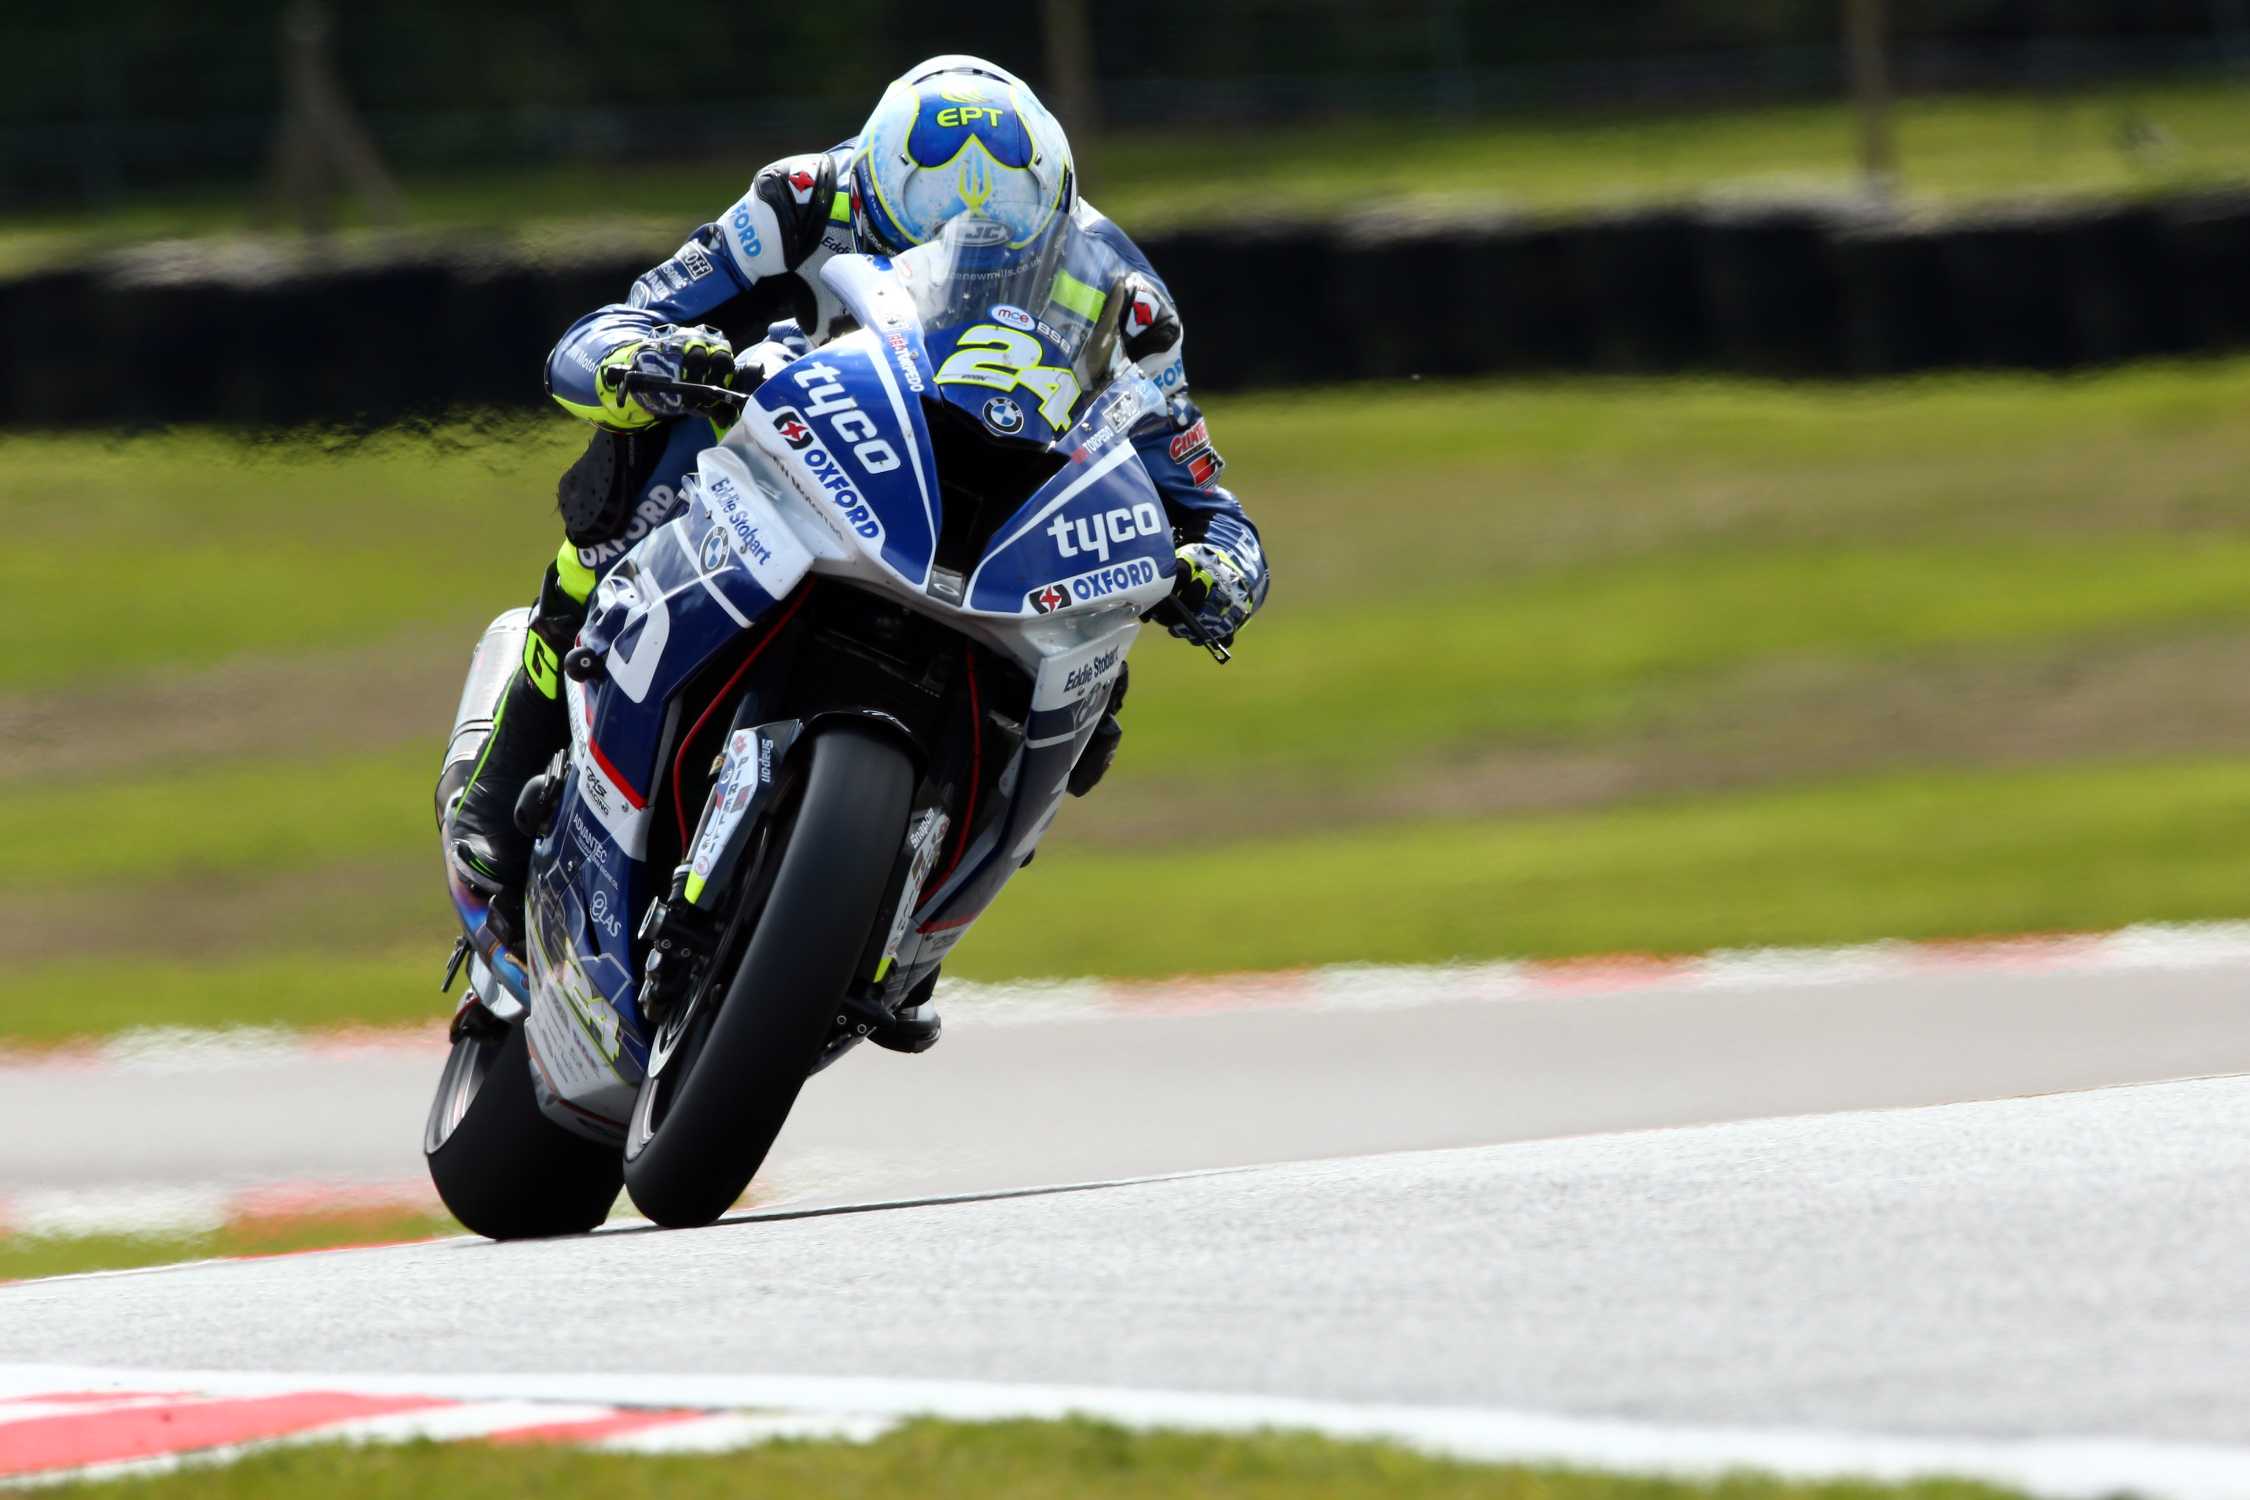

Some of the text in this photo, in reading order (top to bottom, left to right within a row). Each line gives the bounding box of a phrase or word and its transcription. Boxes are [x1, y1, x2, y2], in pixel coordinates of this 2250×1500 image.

[937, 107, 1003, 127] EPT
[998, 308, 1029, 323] mce
[933, 324, 1082, 433] 24
[793, 361, 901, 475] tyco
[804, 449, 880, 539] OXFORD
[729, 509, 773, 566] Stobart
[1047, 502, 1162, 562] tyco
[1072, 561, 1154, 600] OXFORD
[1064, 663, 1093, 692] Eddie
[574, 813, 608, 864] ADVANTEC
